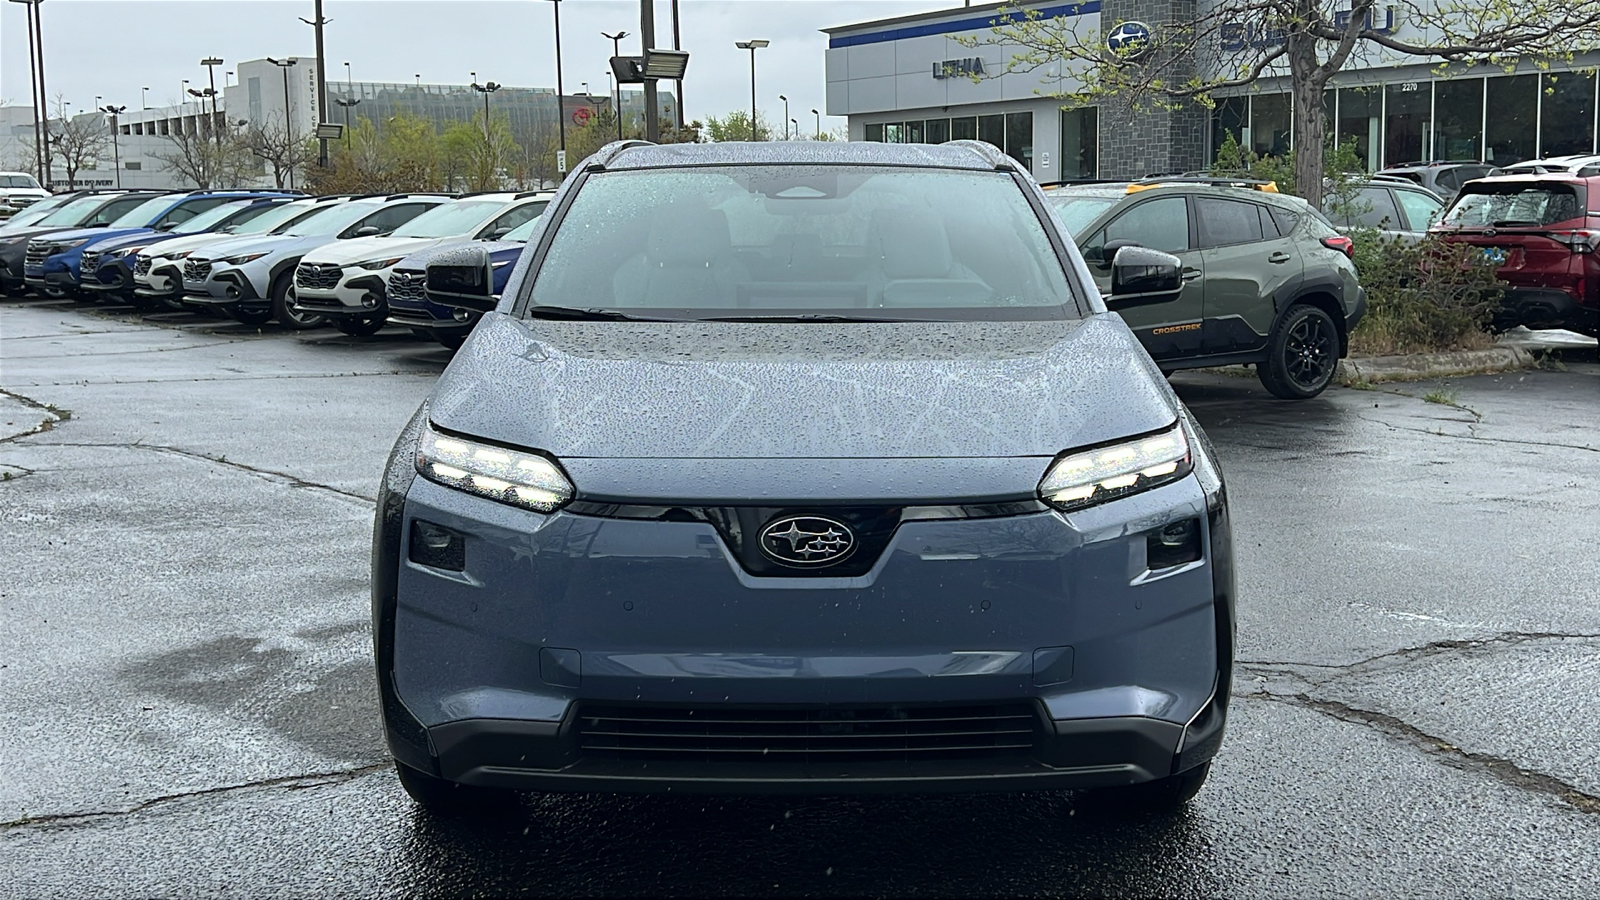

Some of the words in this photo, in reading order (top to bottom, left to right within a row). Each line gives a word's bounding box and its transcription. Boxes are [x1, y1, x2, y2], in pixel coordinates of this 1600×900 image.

[933, 57, 985, 79] LITHIA
[308, 68, 316, 111] SERVICE
[1401, 82, 1418, 92] 2270
[1152, 322, 1202, 335] CROSSTREK
